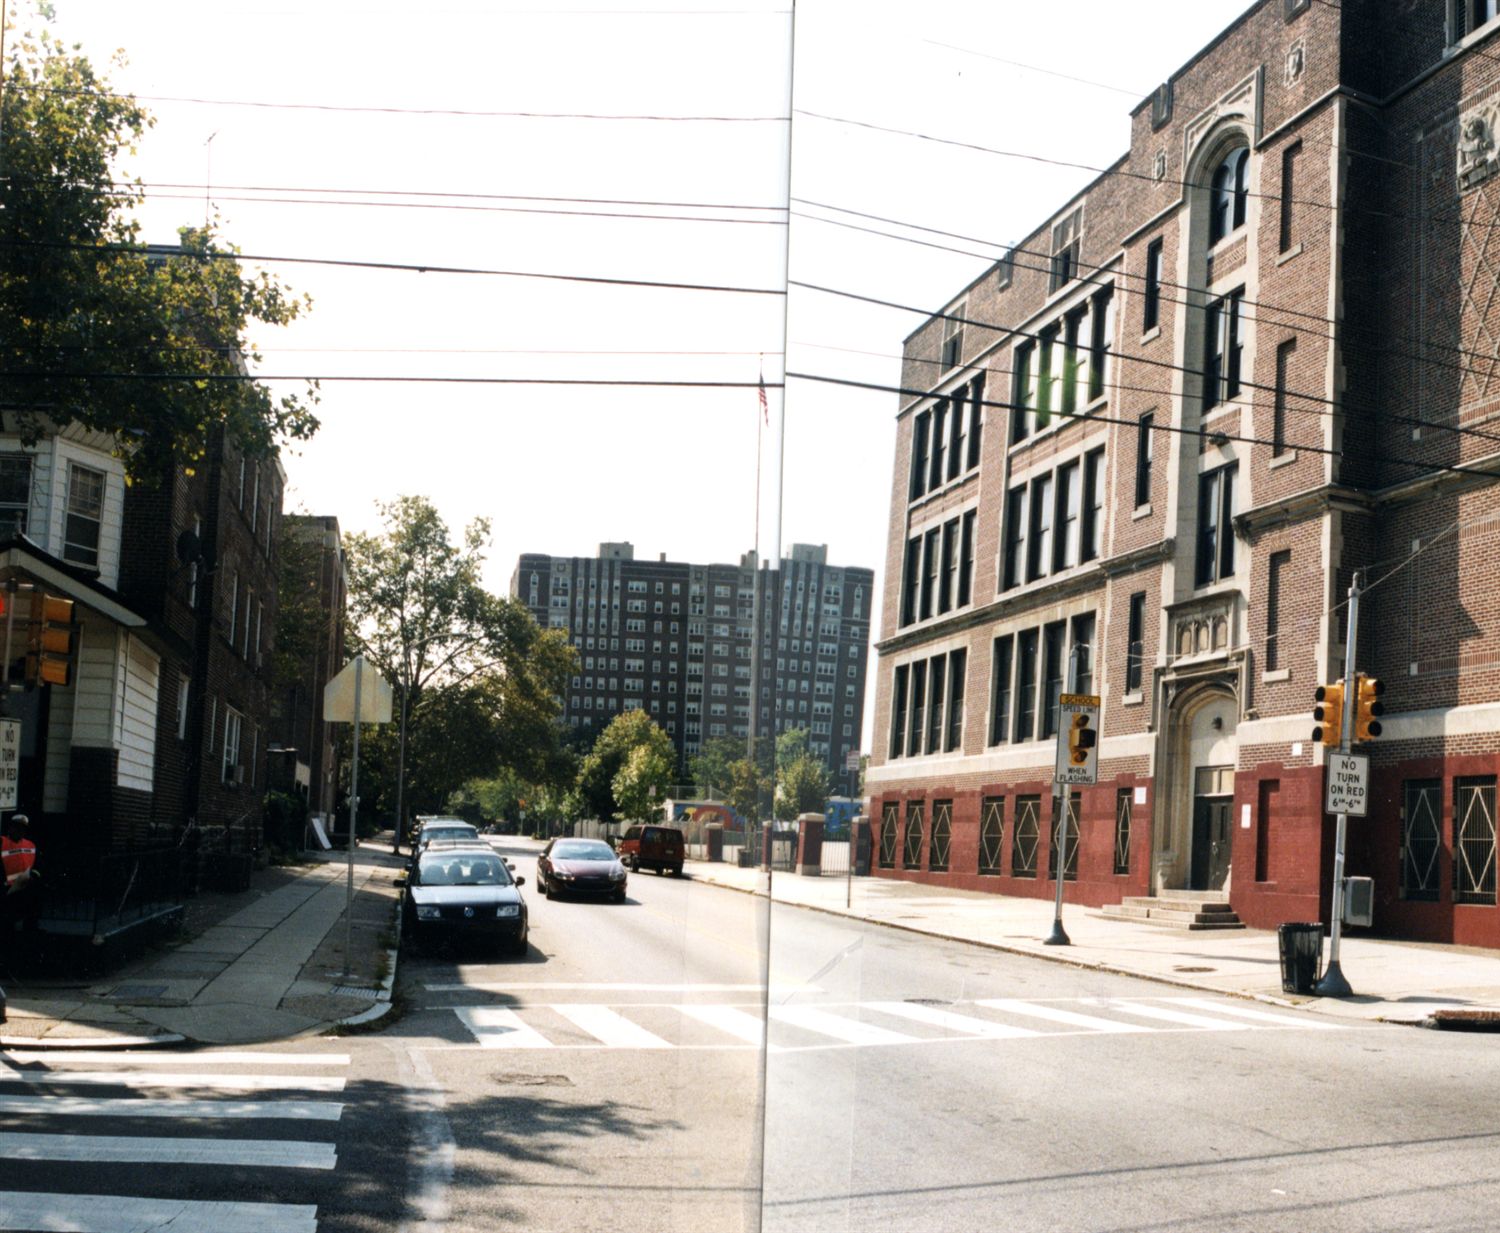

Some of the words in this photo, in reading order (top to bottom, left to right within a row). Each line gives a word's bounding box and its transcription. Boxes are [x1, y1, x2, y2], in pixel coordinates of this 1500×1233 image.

[1064, 696, 1094, 706] SCHOOL
[1062, 705, 1082, 713] SPEED
[5, 729, 14, 743] NO
[2, 748, 15, 762] TURN
[1341, 760, 1356, 770] NO
[7, 768, 16, 781] RED
[1068, 767, 1087, 775] WHEN
[1059, 774, 1093, 783] FLASHING
[1336, 772, 1360, 784] TURN
[1330, 784, 1343, 795] ON
[1346, 785, 1365, 797] RED
